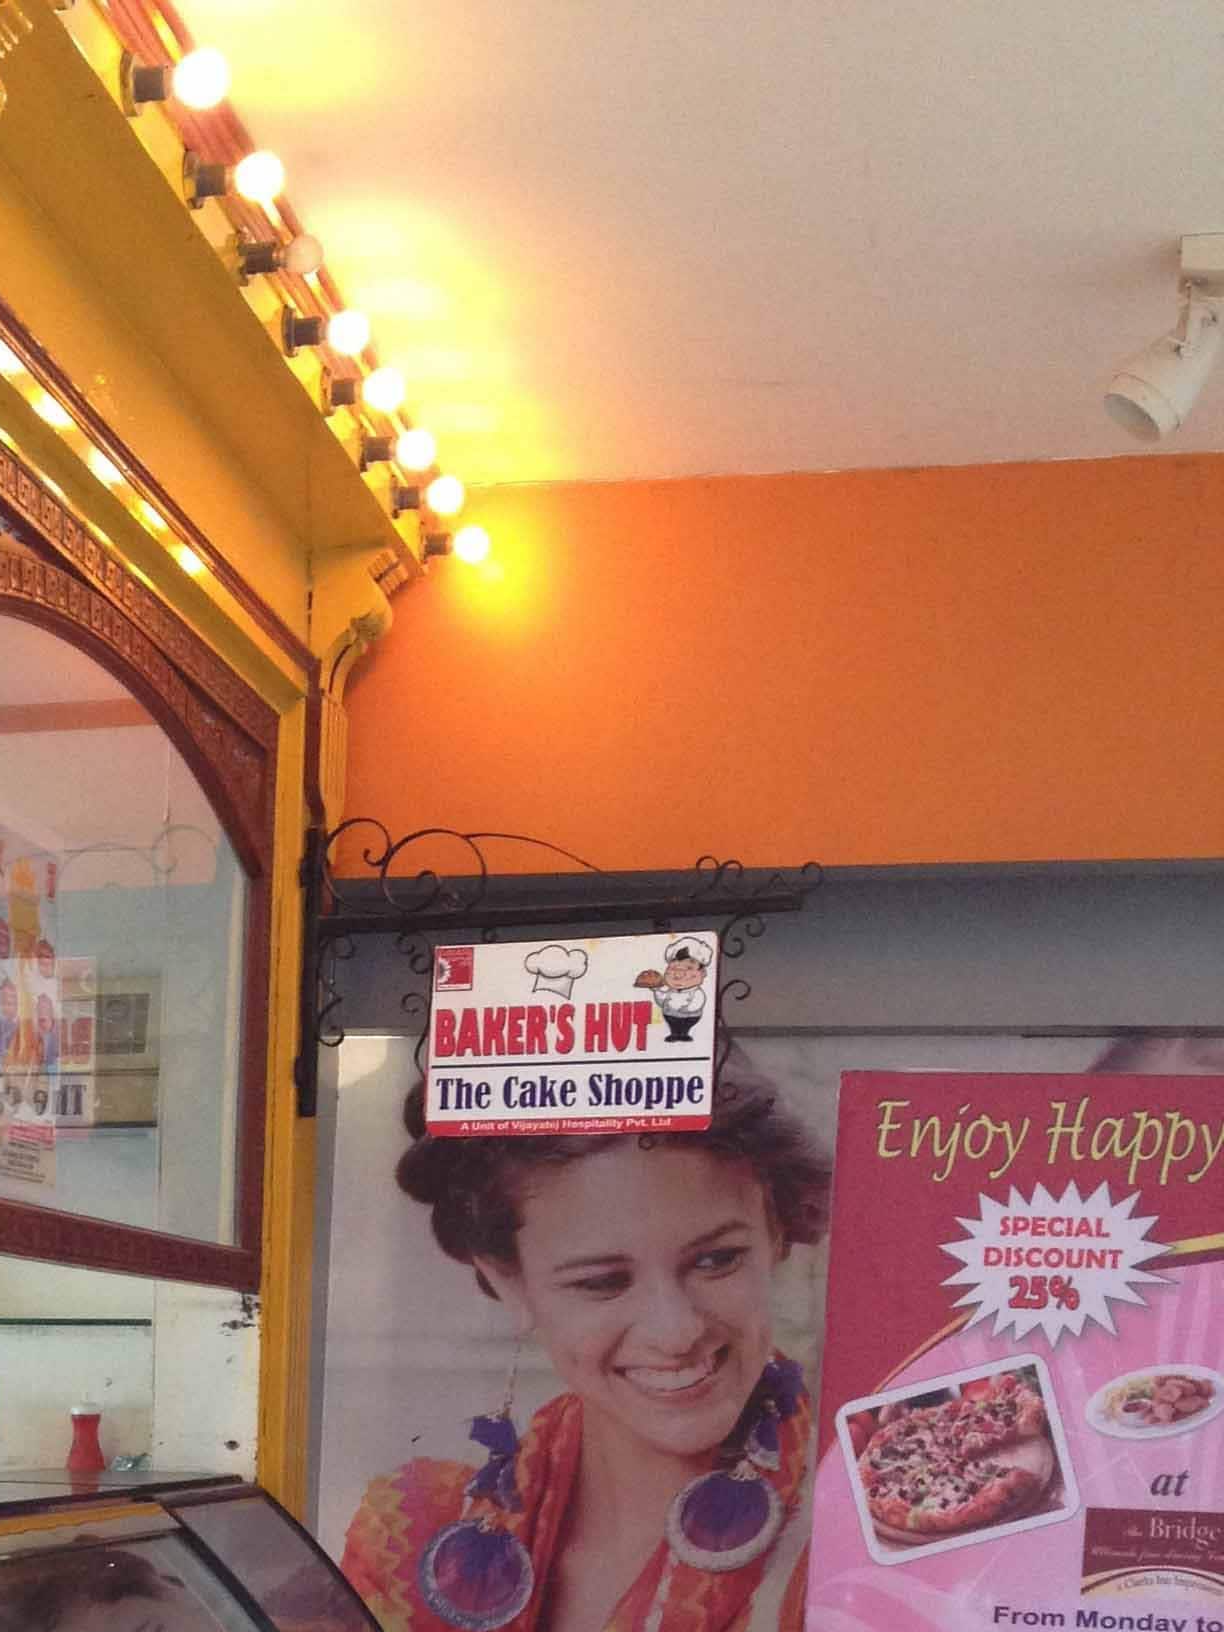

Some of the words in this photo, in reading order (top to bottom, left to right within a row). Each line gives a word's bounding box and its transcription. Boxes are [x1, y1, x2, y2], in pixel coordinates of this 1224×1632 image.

[435, 1003, 576, 1057] BAKER'S
[584, 1000, 653, 1053] HUT
[436, 1077, 491, 1111] The
[503, 1074, 576, 1108] Cake
[588, 1072, 704, 1110] Shoppe
[472, 1121, 495, 1131] Unit
[497, 1120, 509, 1130] of
[562, 1117, 622, 1130] Hospitality
[876, 1099, 1030, 1181] Enjoy
[1046, 1096, 1224, 1185] Happy
[1000, 1216, 1110, 1239] SPECIAL
[982, 1247, 1123, 1270] DISCOUNT
[1008, 1275, 1081, 1311] 25%
[1150, 1470, 1190, 1497] at
[993, 1606, 1065, 1627] From
